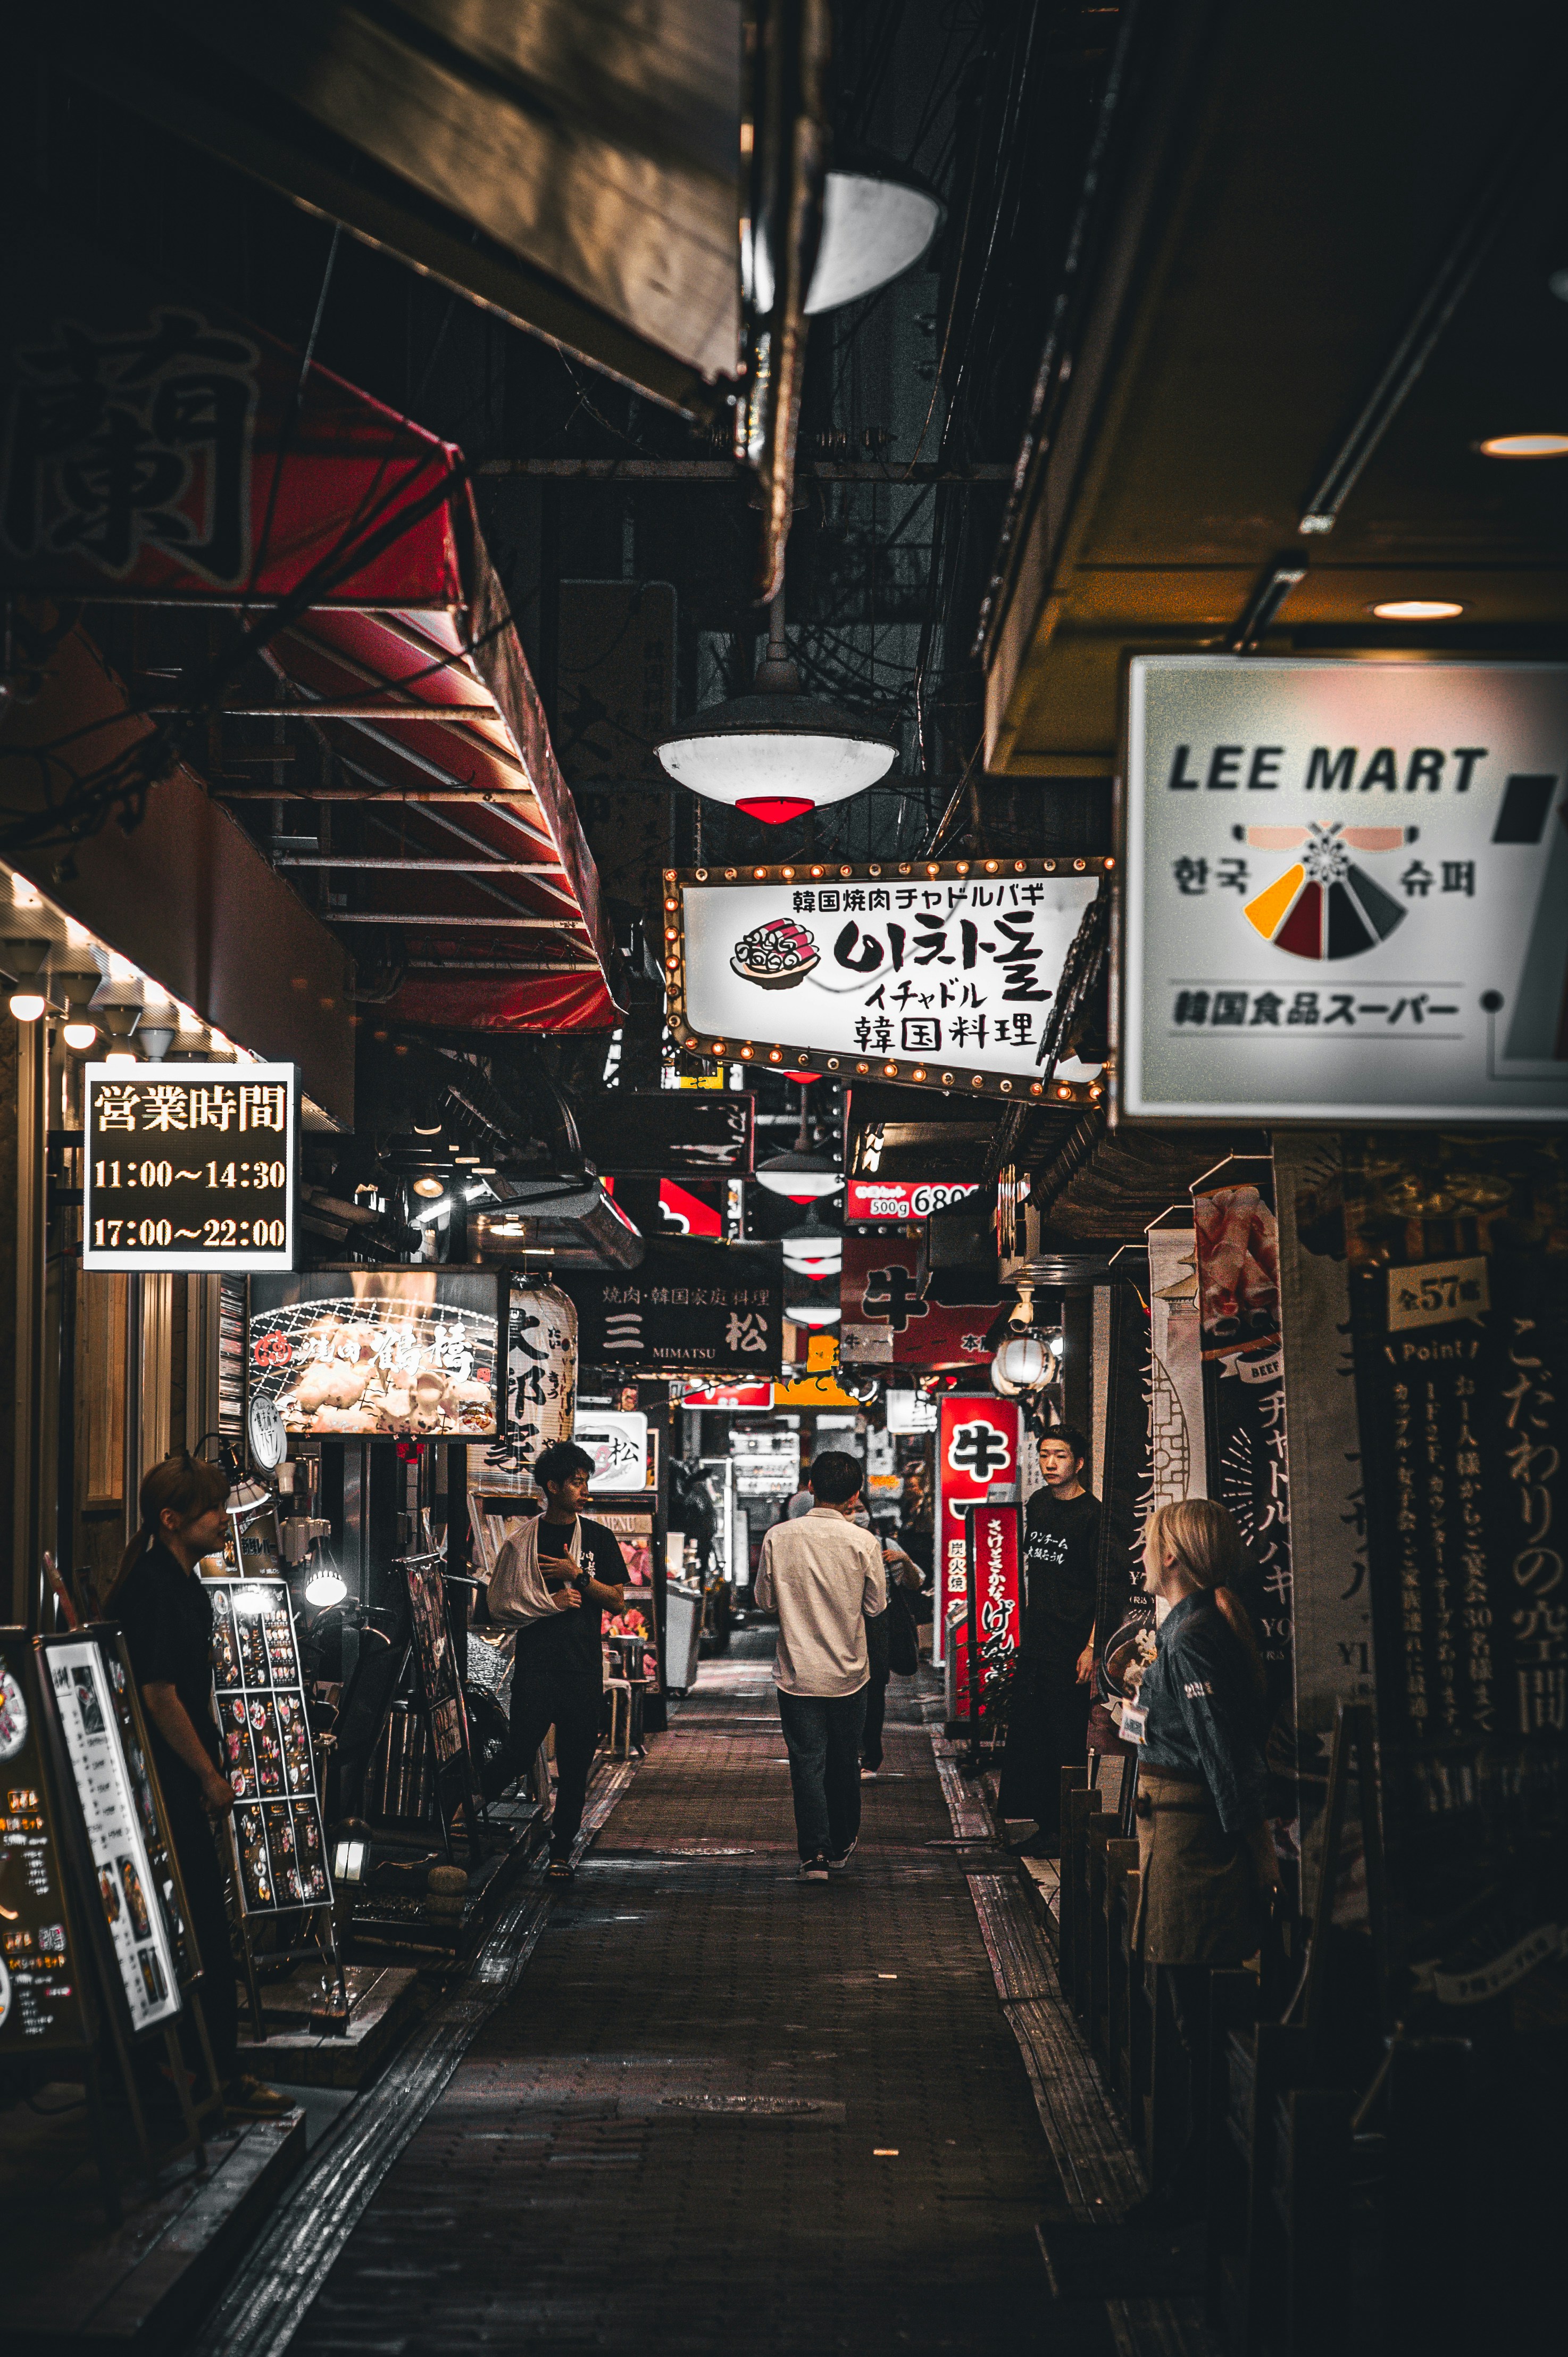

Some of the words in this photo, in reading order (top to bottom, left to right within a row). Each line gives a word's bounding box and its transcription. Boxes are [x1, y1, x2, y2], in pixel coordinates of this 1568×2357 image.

[1168, 744, 1287, 791] LEE
[1305, 746, 1488, 792] MART
[1173, 856, 1251, 896] 한국
[1399, 860, 1476, 898] 슈퍼
[793, 883, 1045, 913] 韓国焼肉チャドルバギ
[865, 978, 988, 1011] イチャドル
[1173, 991, 1460, 1026] 韓国食品スーパー
[853, 1013, 1038, 1054] 韓国料理
[94, 1084, 286, 1132] 営業時間
[94, 1160, 285, 1189] 11:00～14:30
[873, 1201, 908, 1216] 500g
[914, 1186, 979, 1214] 680
[94, 1219, 285, 1247] 17:00～22:00
[653, 1347, 716, 1358] MIMATSU
[1403, 1339, 1462, 1362] Point
[1251, 1362, 1280, 1378] BEEF
[949, 1421, 1010, 1482] 牛
[1501, 1316, 1567, 1735] こだわりの空間
[987, 1518, 1006, 1601] さけとさかな
